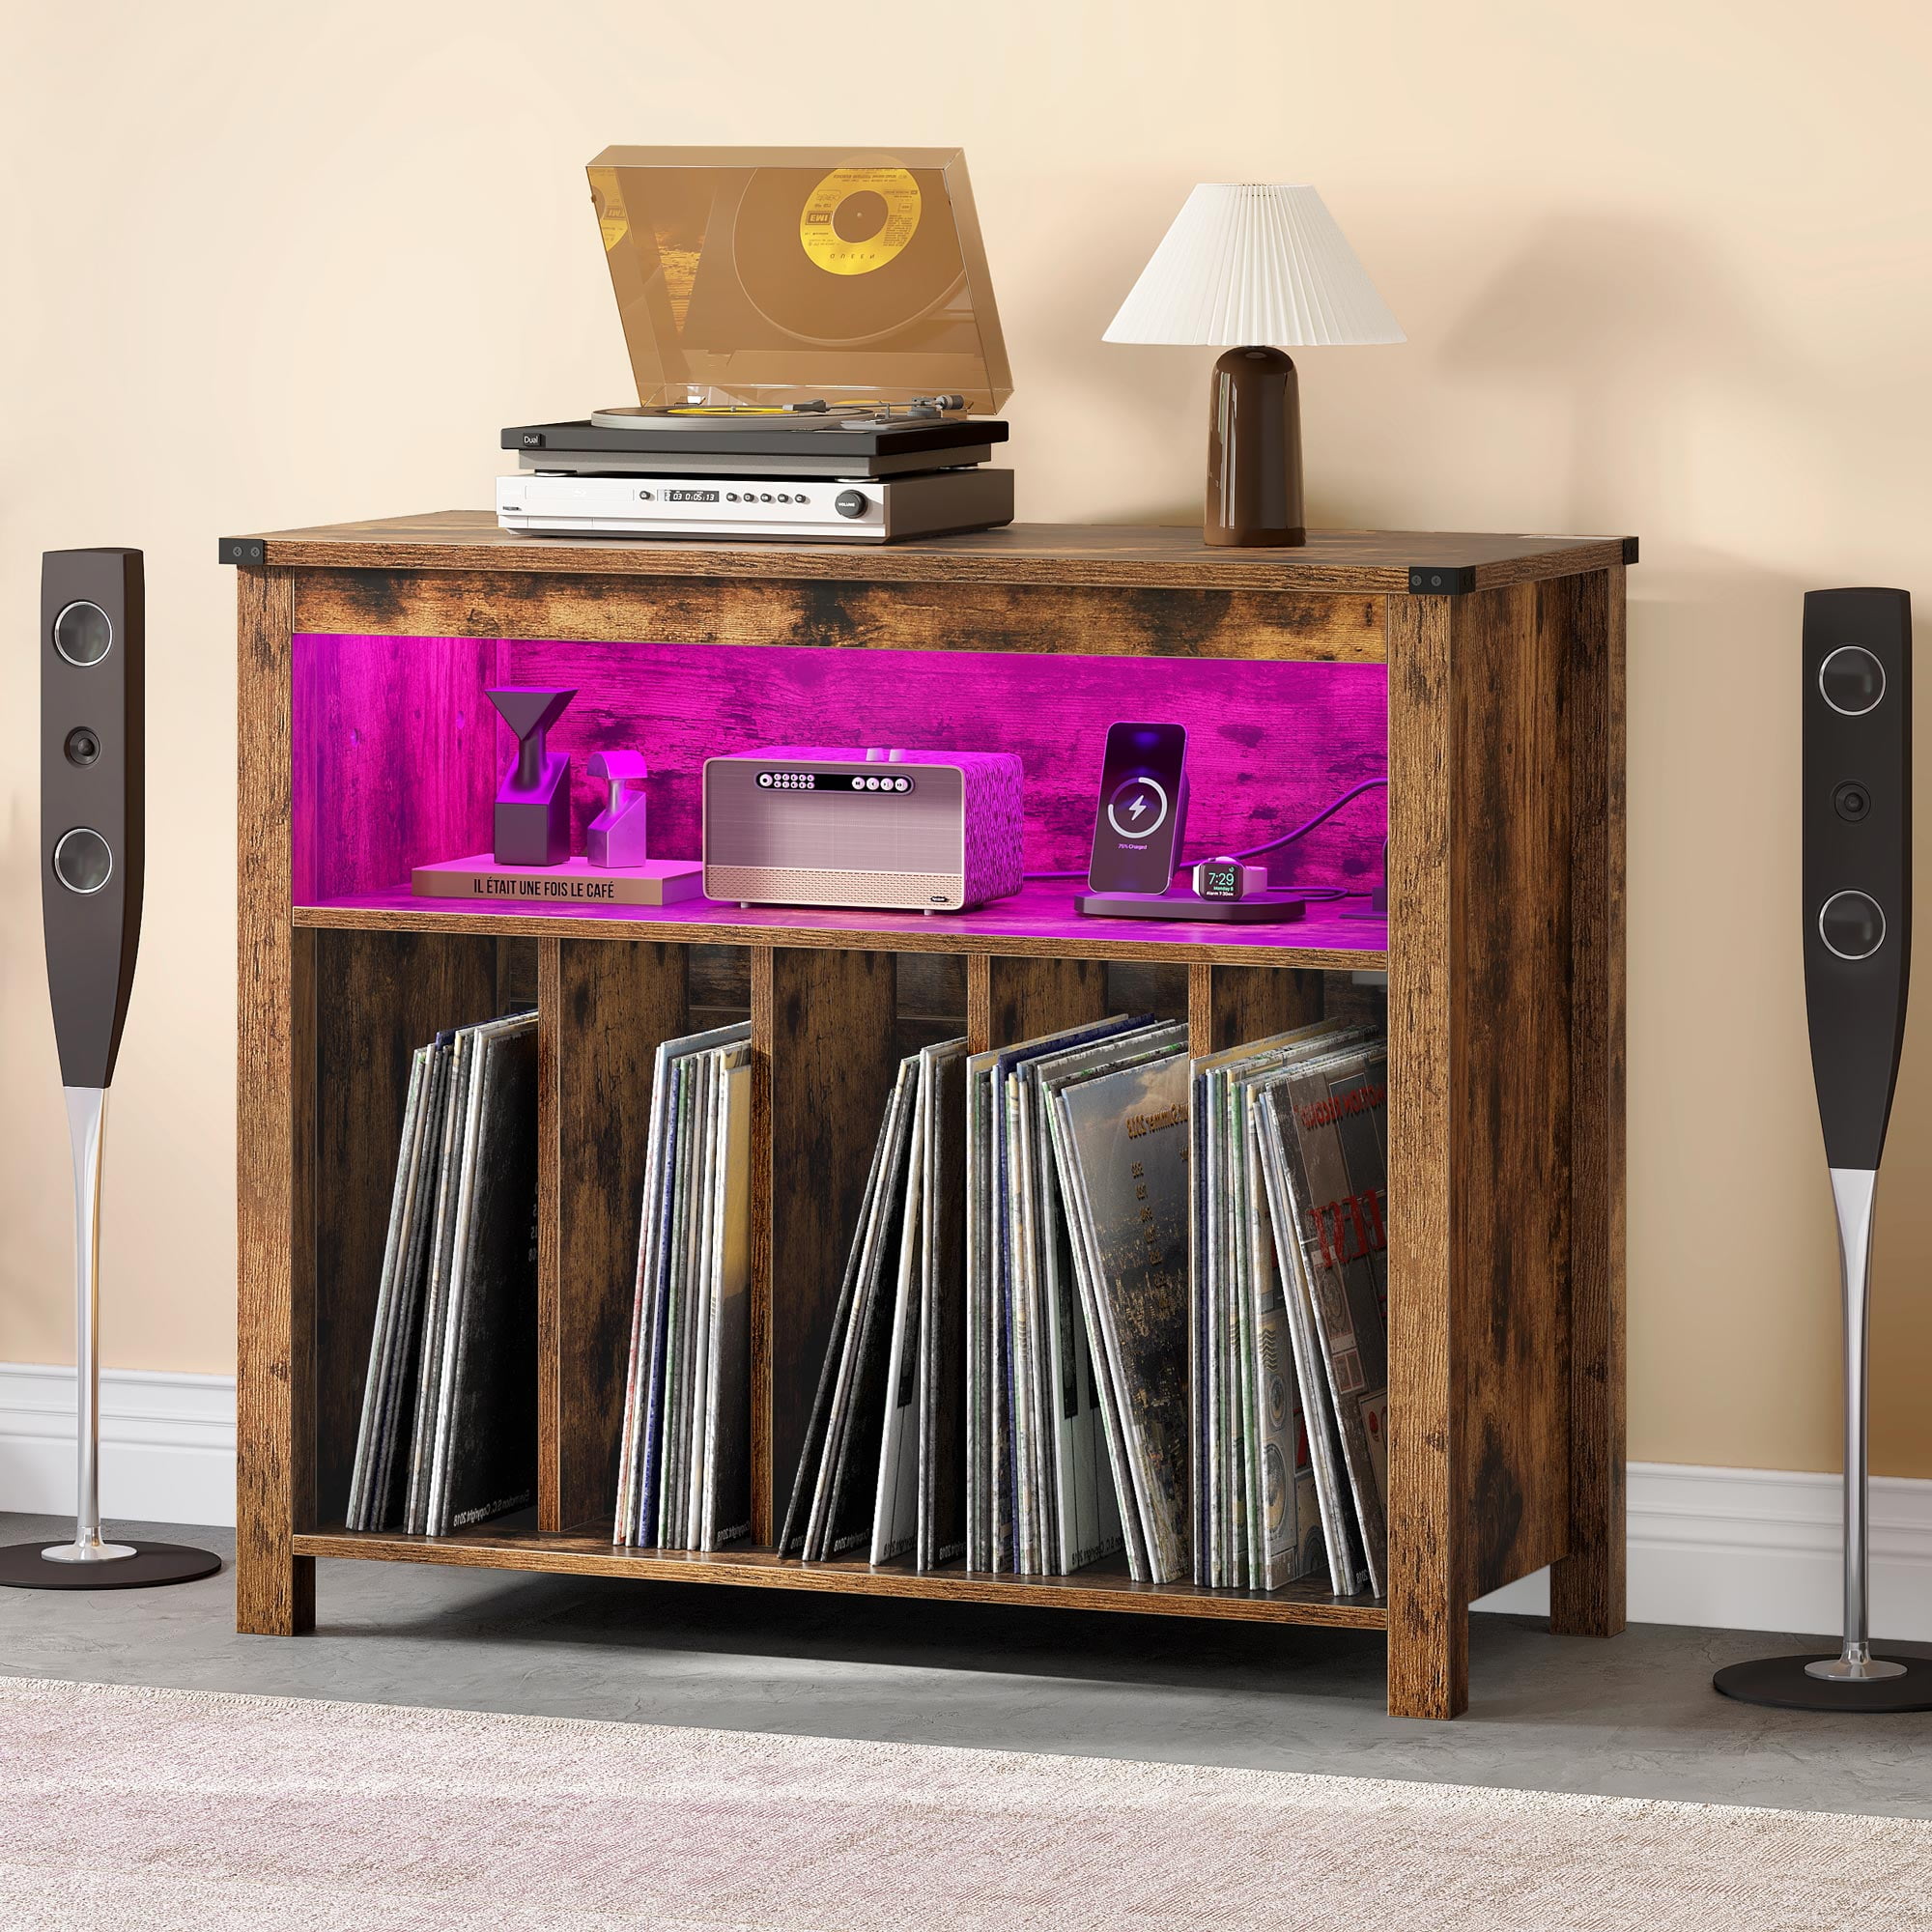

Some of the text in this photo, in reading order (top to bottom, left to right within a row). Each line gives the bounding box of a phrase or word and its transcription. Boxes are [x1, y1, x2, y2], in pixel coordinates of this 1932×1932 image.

[524, 436, 539, 444] Dual
[1208, 872, 1235, 886] 7:29
[473, 876, 614, 898] IL ÉTAIT UNE FOIS LE CAFÉ
